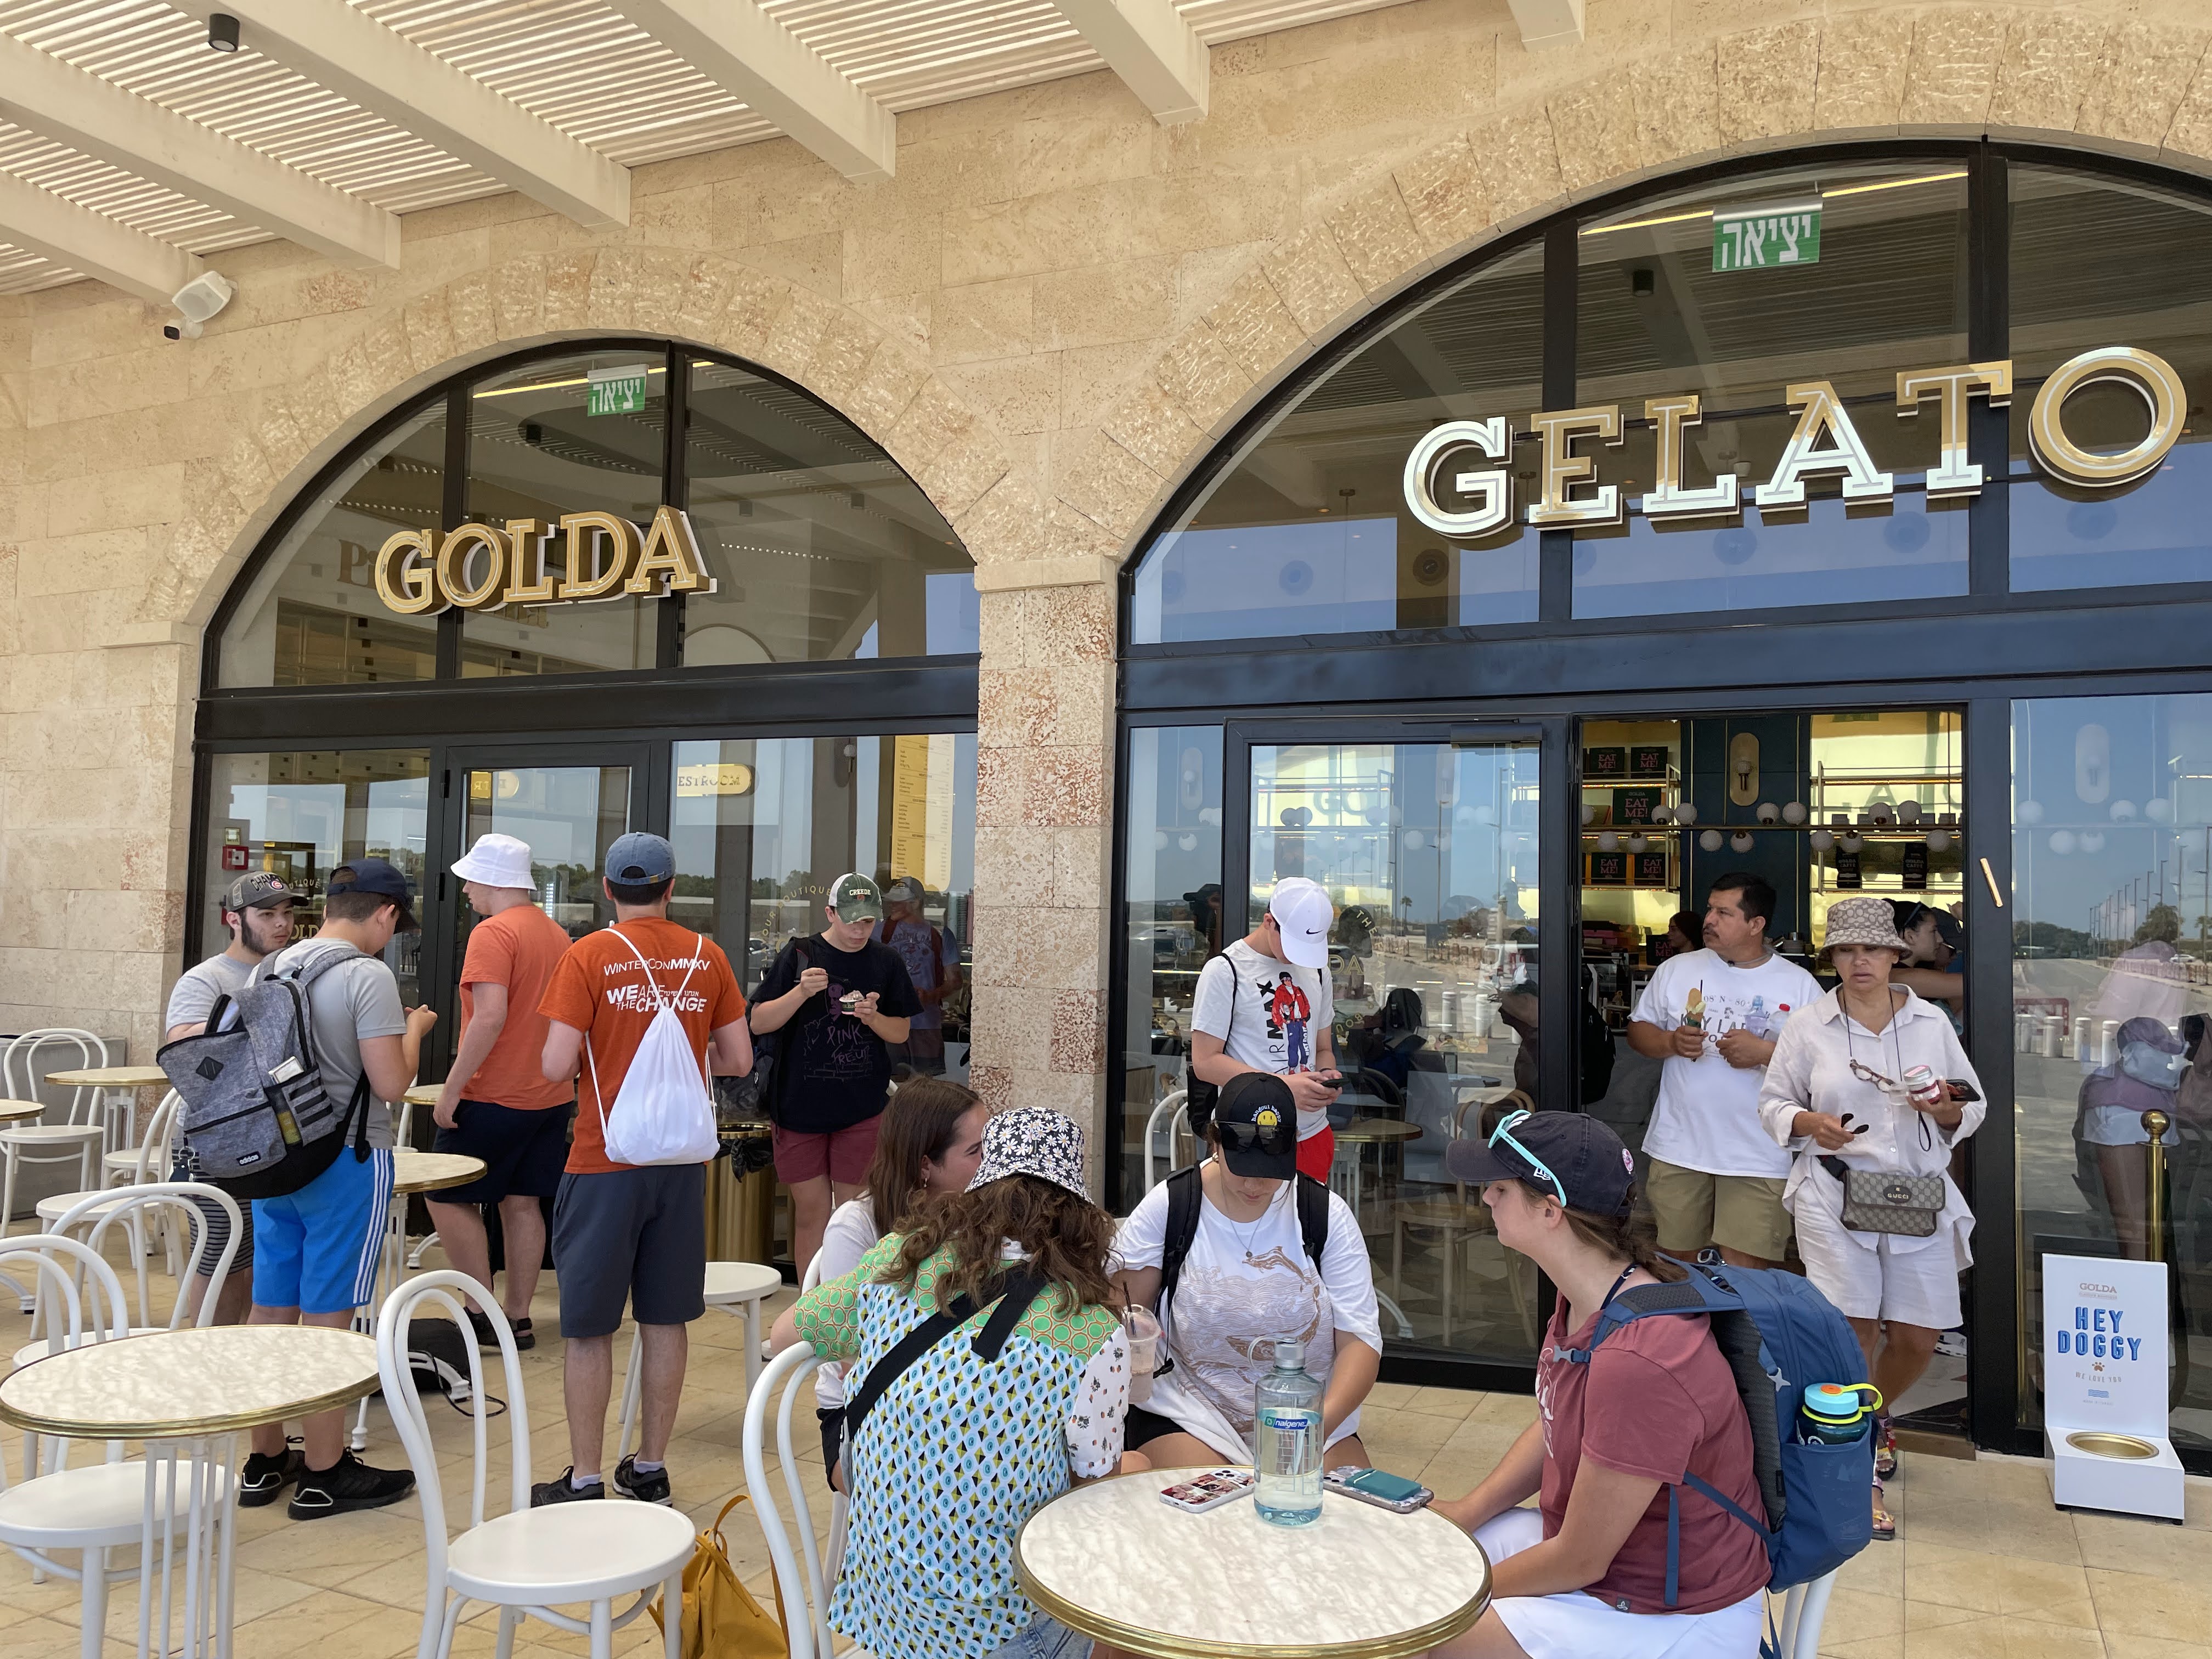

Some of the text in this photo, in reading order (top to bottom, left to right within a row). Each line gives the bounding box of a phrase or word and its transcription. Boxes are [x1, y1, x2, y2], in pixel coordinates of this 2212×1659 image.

[1722, 215, 1810, 268] יציאה
[592, 378, 640, 413] יציאה
[1402, 346, 2187, 540] GELATO
[375, 505, 716, 615] GOLDA
[678, 775, 741, 786] ESTROOM
[1625, 798, 1649, 808] EAT
[1624, 808, 1648, 817] ME!
[289, 878, 321, 889] UTIQUE
[1356, 910, 1378, 938] THE
[291, 924, 319, 940] OLD
[616, 1000, 636, 1012] THE
[827, 1019, 864, 1046] PINK
[239, 1154, 258, 1164] adidas
[2080, 1283, 2117, 1294] GOLDA
[2075, 1307, 2124, 1334] HEY
[2058, 1330, 2142, 1361] DOGGY
[2089, 1374, 2105, 1383] LOVE
[1275, 1419, 1305, 1429] nalgene
